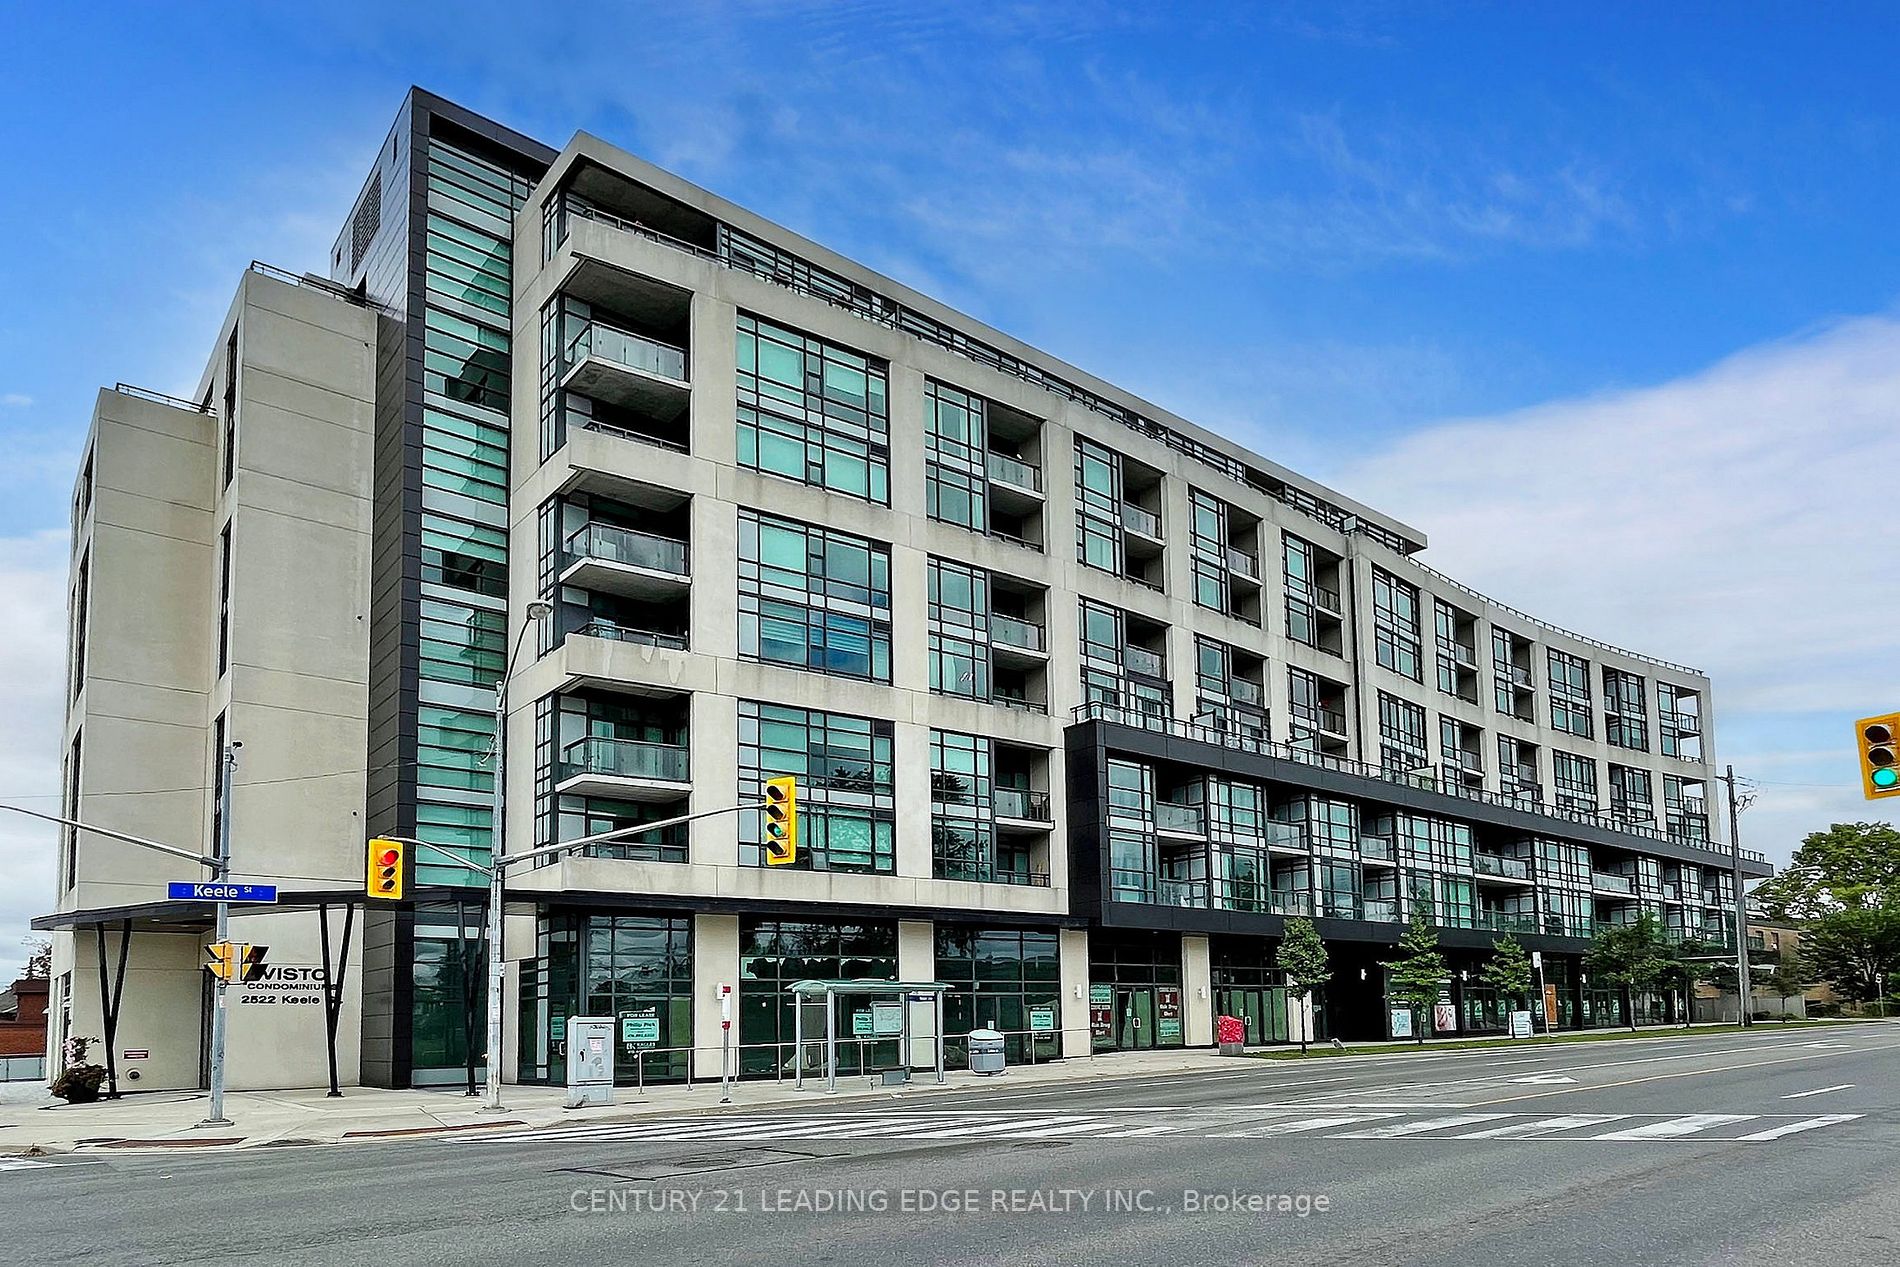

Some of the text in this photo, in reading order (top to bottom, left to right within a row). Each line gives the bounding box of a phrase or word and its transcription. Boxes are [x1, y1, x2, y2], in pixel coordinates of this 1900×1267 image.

[194, 884, 239, 898] Keele
[241, 995, 276, 1005] 2522
[282, 995, 320, 1005] Keele
